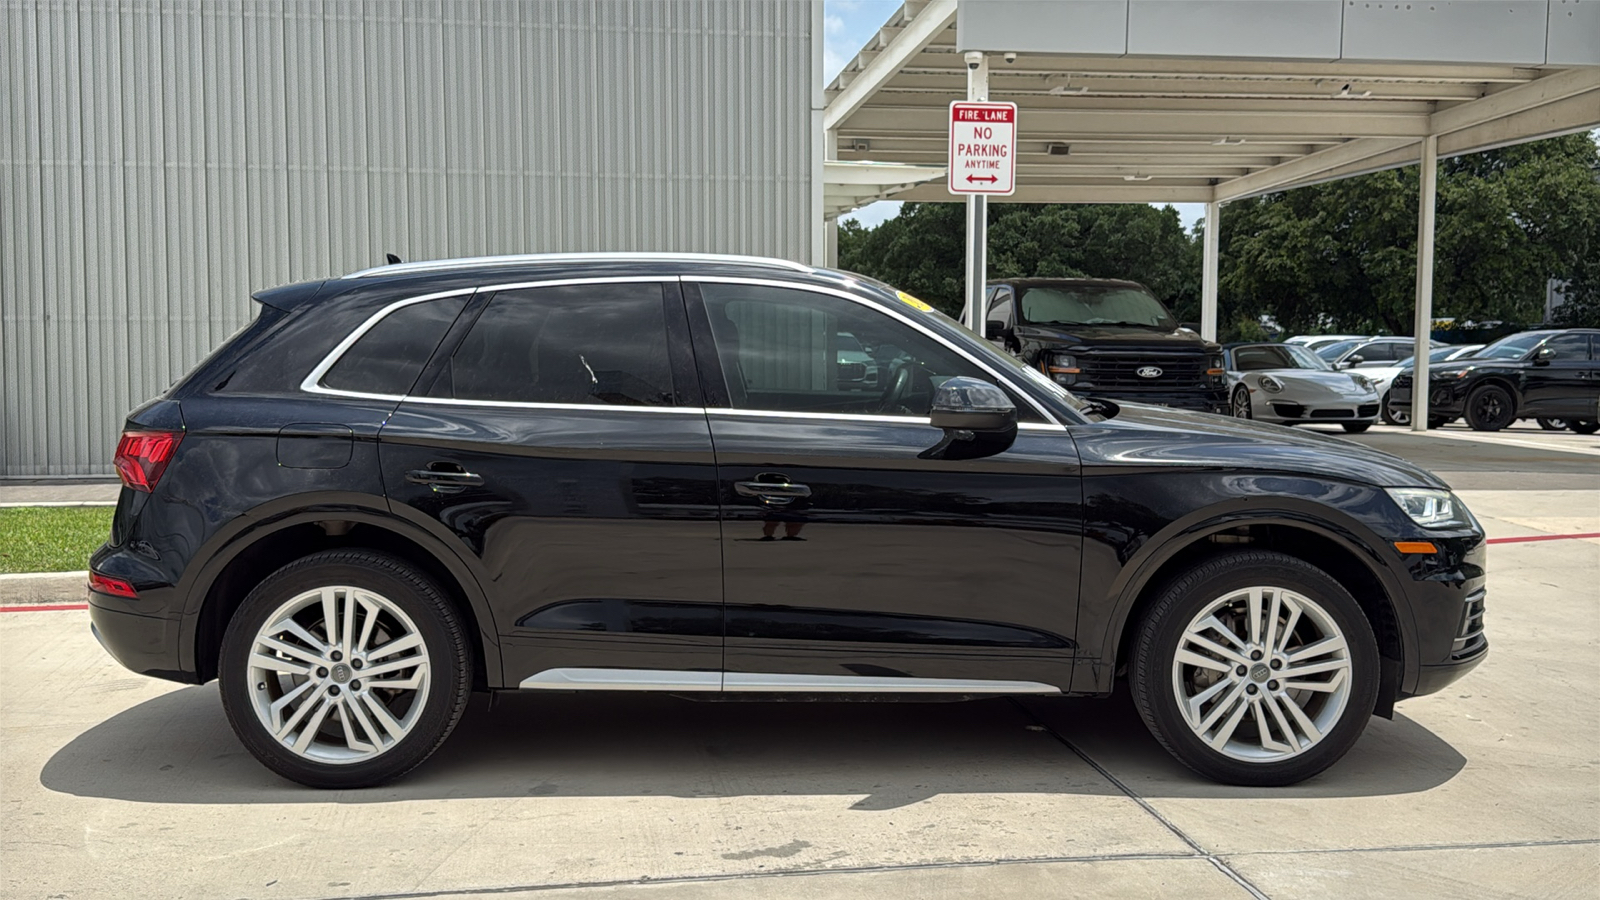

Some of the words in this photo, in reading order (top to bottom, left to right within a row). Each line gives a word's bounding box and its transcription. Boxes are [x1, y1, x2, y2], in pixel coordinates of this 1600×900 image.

[959, 110, 979, 120] FIRE
[984, 111, 1008, 121] LANE
[974, 126, 992, 140] NO
[958, 143, 1007, 157] PARKING
[965, 160, 1000, 169] ANYTIME
